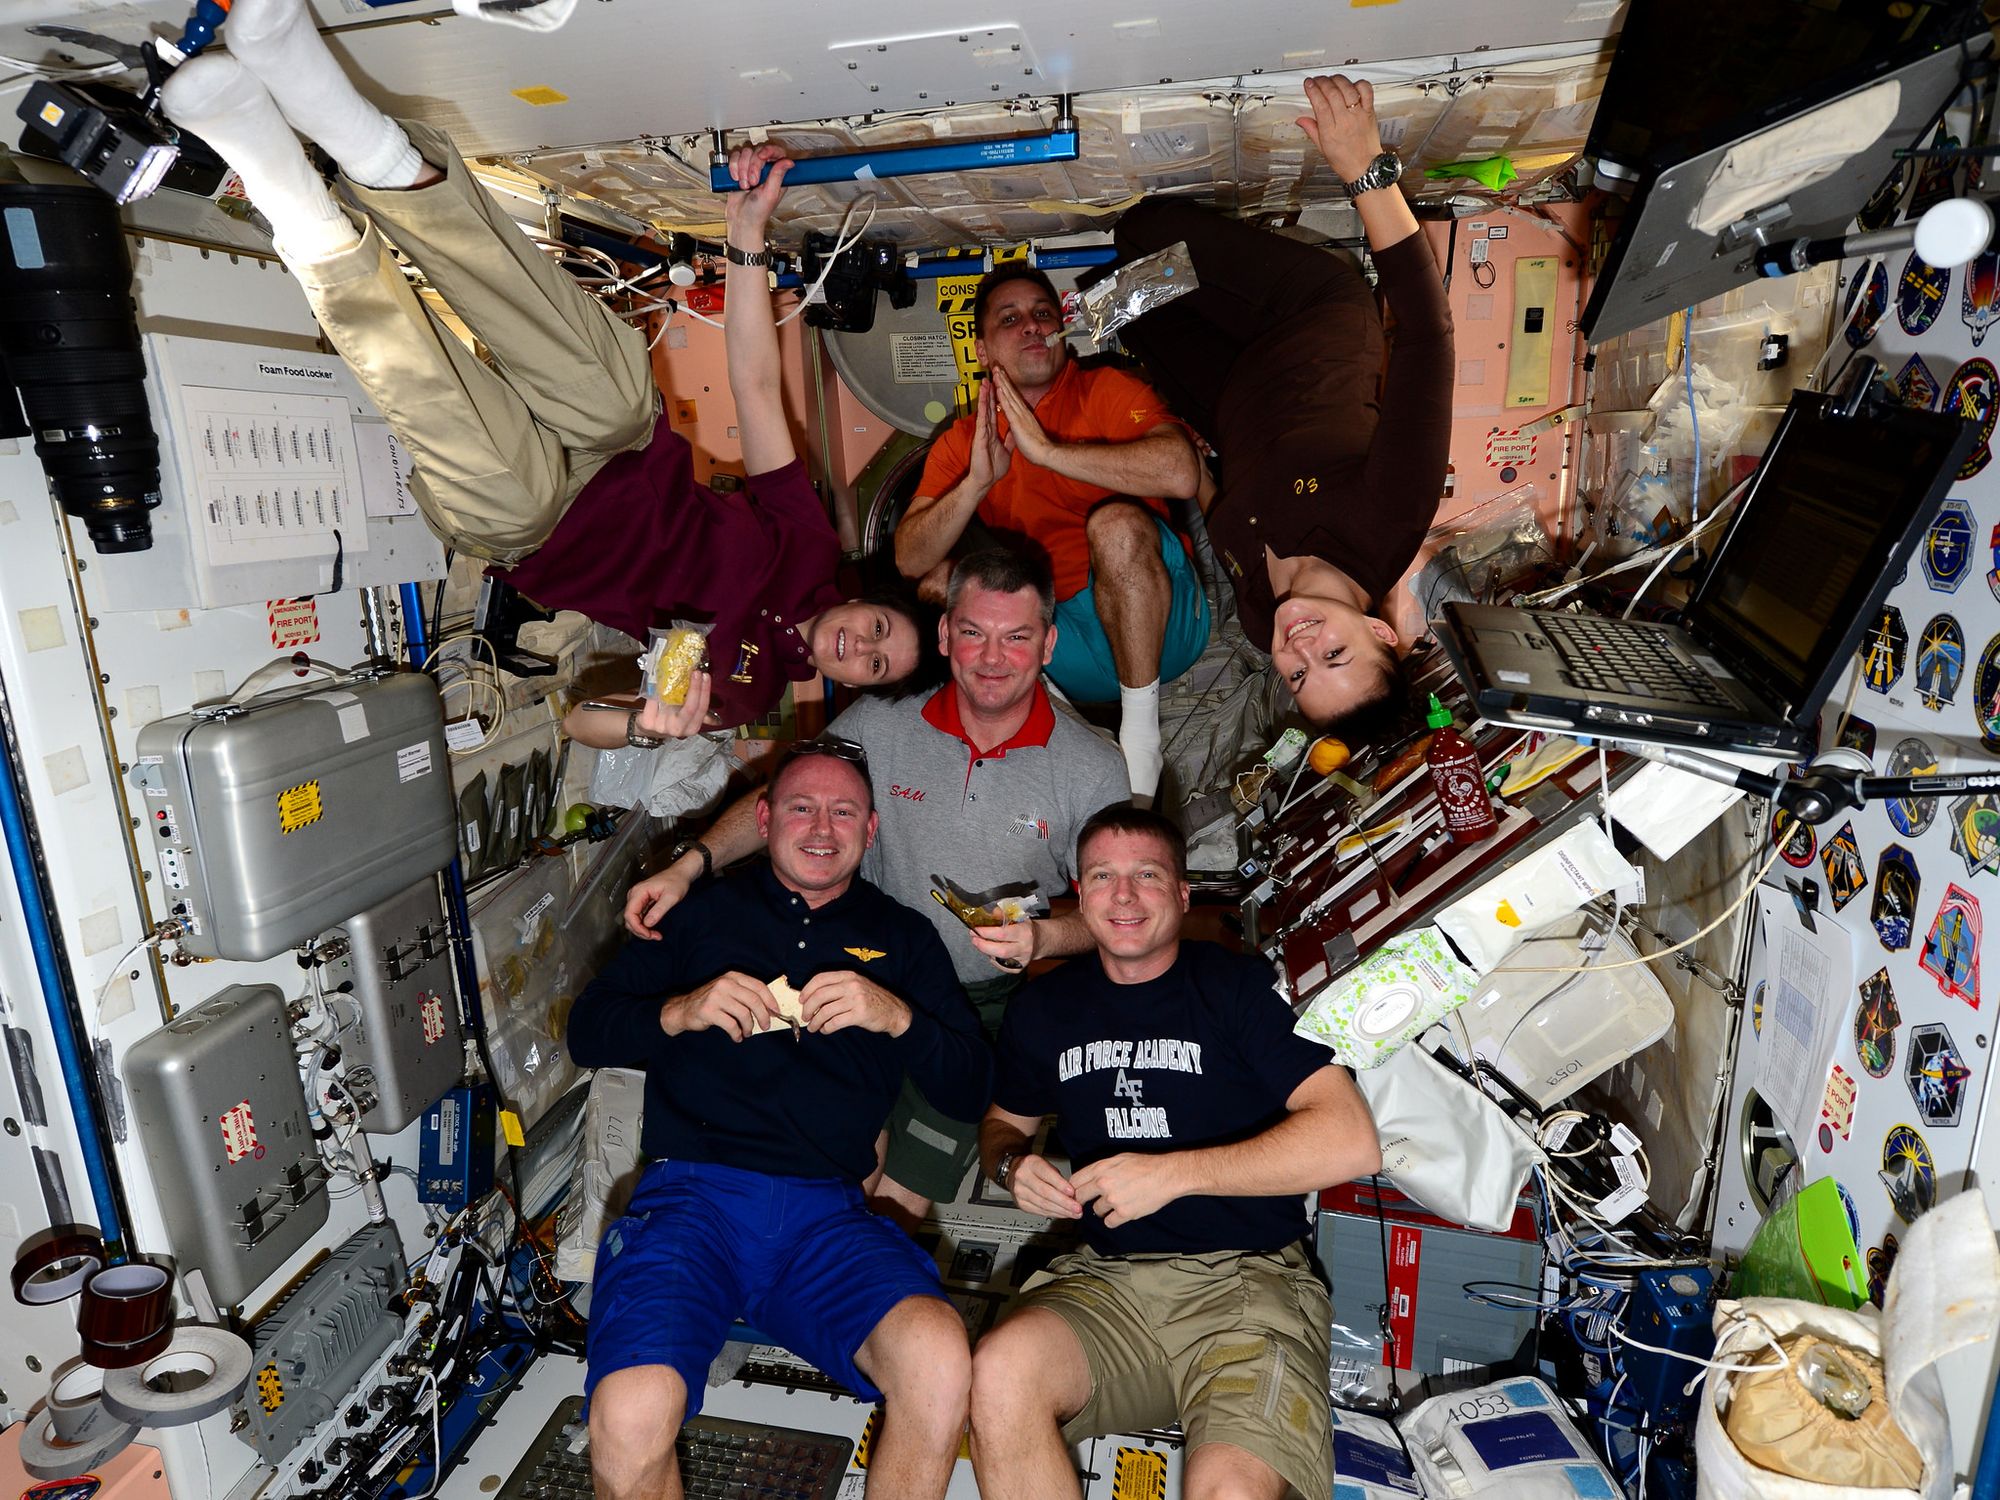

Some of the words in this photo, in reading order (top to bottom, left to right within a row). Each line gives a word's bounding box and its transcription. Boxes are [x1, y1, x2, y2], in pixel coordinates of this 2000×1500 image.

[259, 364, 284, 375] Foam
[284, 366, 305, 377] Food
[305, 366, 333, 380] Locker
[277, 619, 293, 628] FIRE
[294, 616, 312, 625] PORT
[890, 784, 926, 802] SAM
[1558, 850, 1584, 883] DISINFECTANT
[1059, 1046, 1082, 1082] AIR
[1085, 1040, 1133, 1073] FORCE
[1133, 1039, 1203, 1074] ACADEMY
[1114, 1068, 1145, 1106] AF
[1831, 1092, 1849, 1112] PORT
[232, 1114, 240, 1131] FIRE
[236, 1133, 245, 1151] PORT
[607, 1115, 625, 1148] 1377
[1448, 1394, 1510, 1422] 4053
[1499, 1434, 1516, 1443] ASTRO
[1517, 1432, 1537, 1441] PALATE
